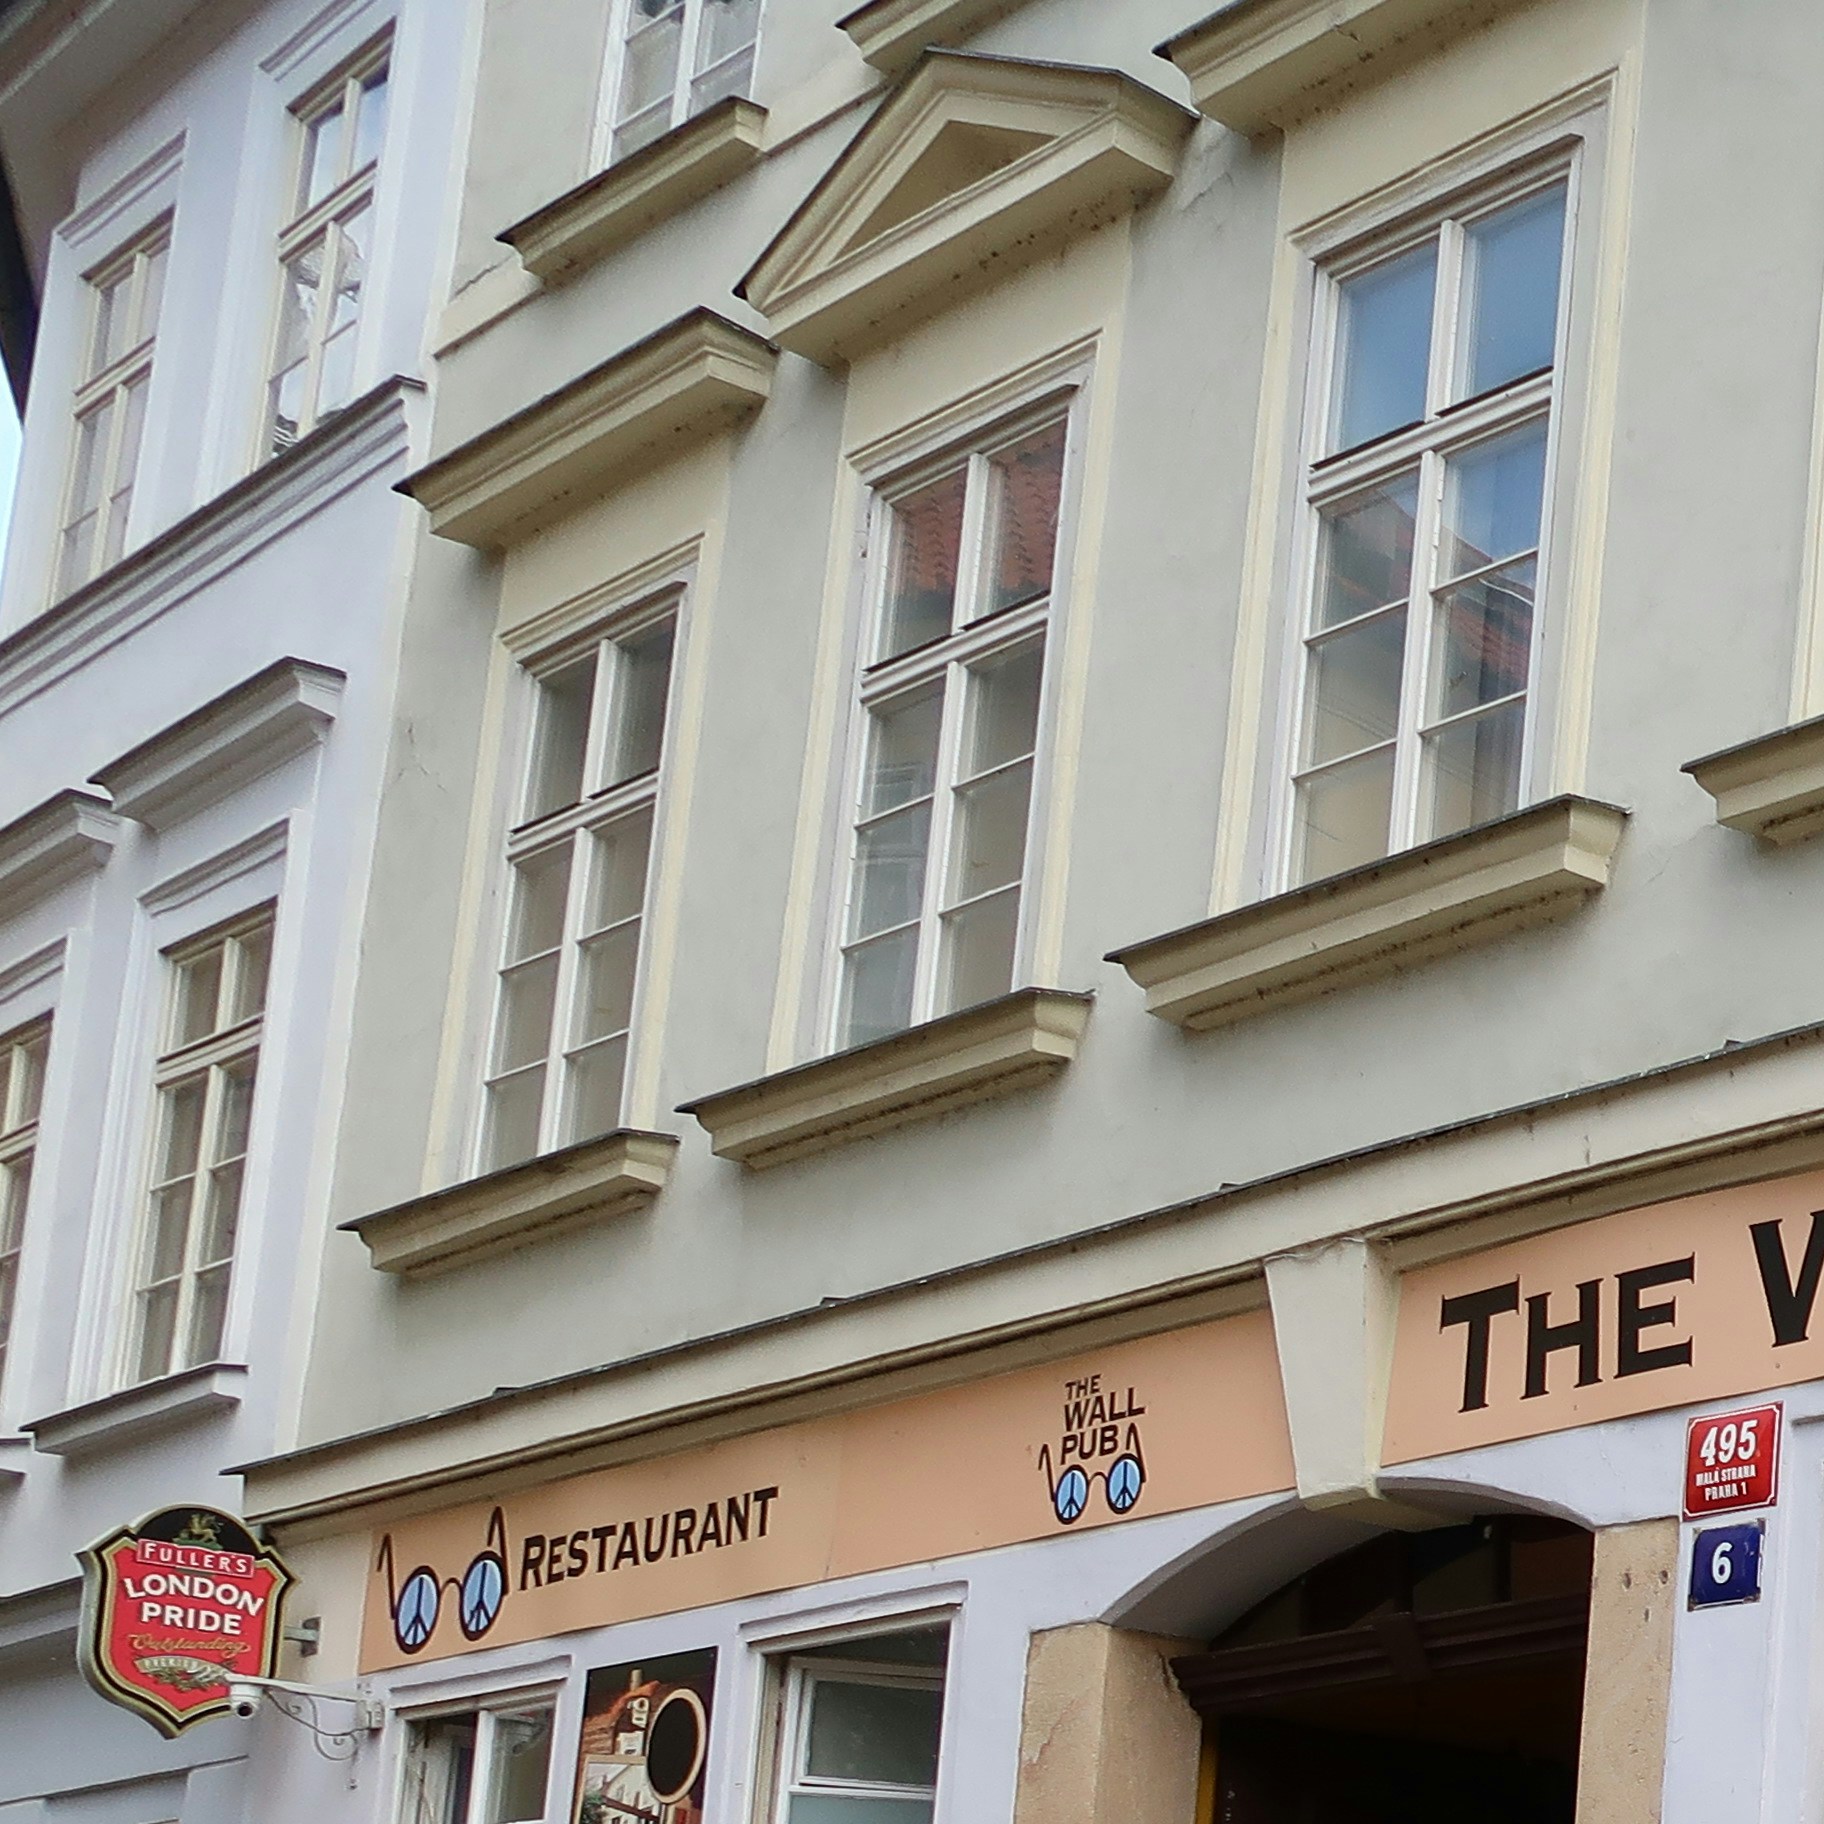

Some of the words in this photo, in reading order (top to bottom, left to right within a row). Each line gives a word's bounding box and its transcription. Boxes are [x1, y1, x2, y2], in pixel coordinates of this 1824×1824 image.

[1440, 1252, 1696, 1413] THE
[1065, 1374, 1101, 1400] THE
[1064, 1387, 1146, 1431] WALL
[1060, 1424, 1118, 1465] PUB
[1700, 1420, 1758, 1466] 495
[1705, 1485, 1739, 1501] PRAHA
[1741, 1482, 1747, 1495] 1
[1721, 1465, 1756, 1482] STRANA
[144, 1543, 247, 1574] FULLER'S
[519, 1487, 780, 1591] RESTAURANT
[1712, 1542, 1734, 1585] 6
[124, 1574, 264, 1616] LONDON
[141, 1602, 242, 1635] PRIDE
[128, 1633, 251, 1658] Outstanding
